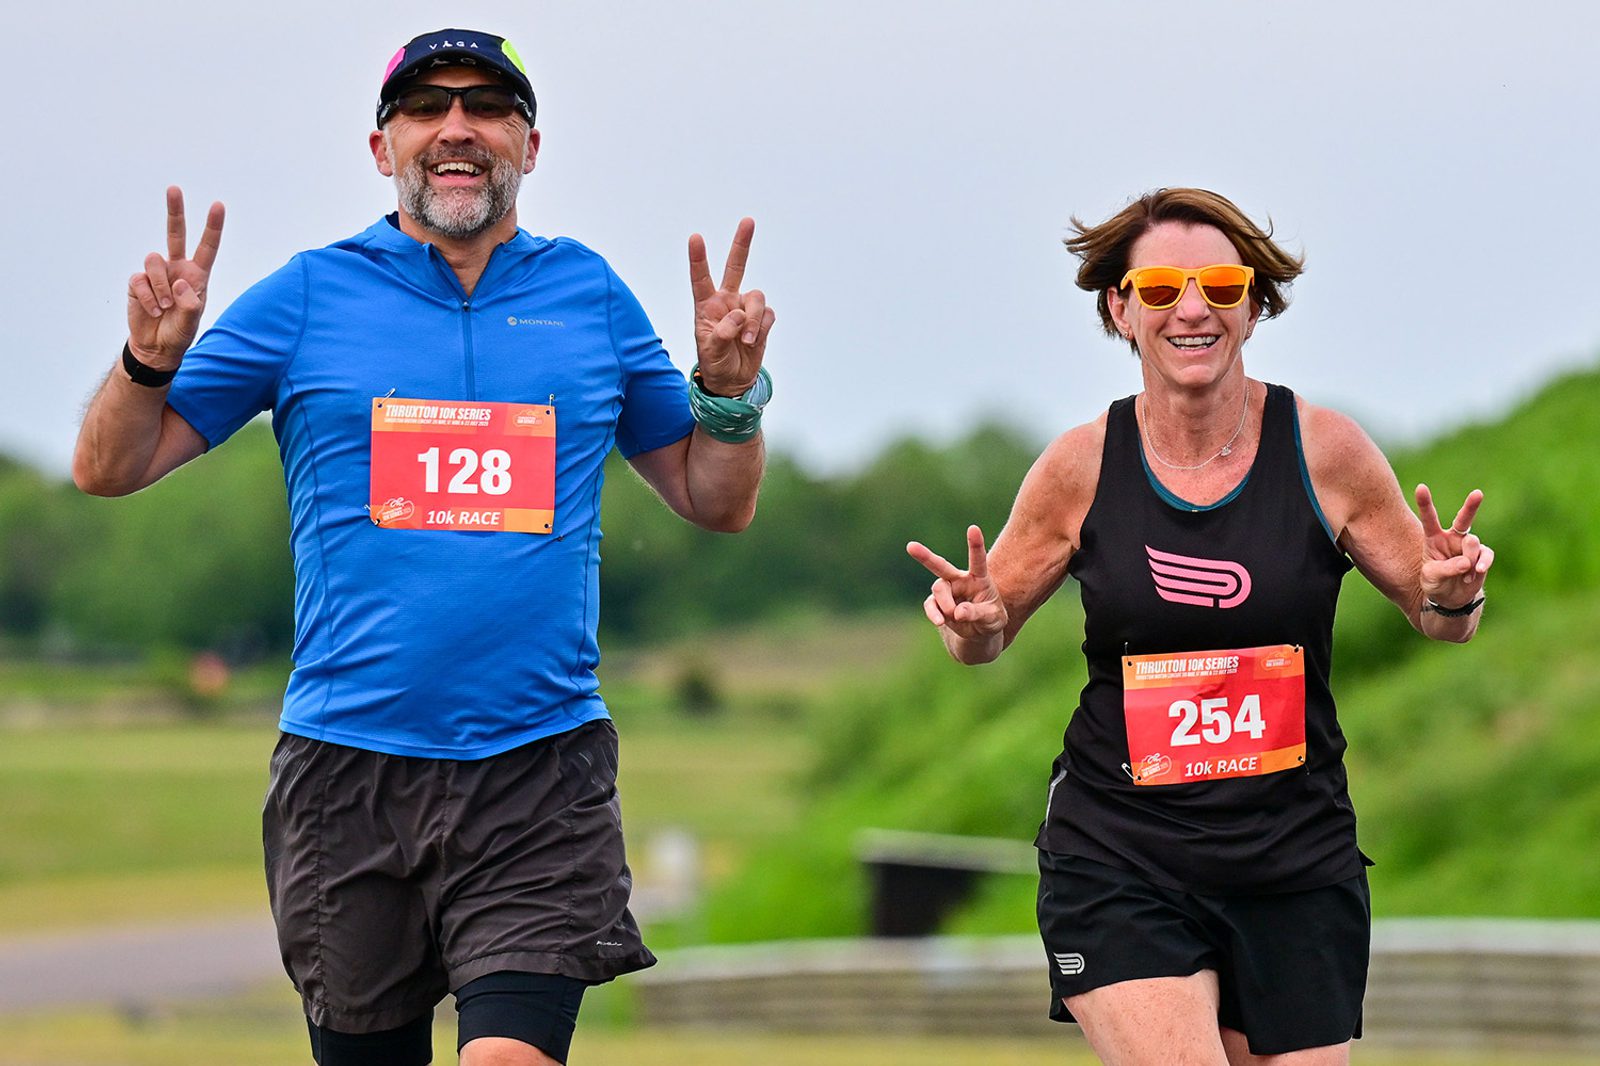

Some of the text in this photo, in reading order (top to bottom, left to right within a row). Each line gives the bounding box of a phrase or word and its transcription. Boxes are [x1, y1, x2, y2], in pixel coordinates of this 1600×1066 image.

[385, 404, 491, 421] THRUXTON 10K SERIES
[417, 447, 512, 495] 128
[426, 510, 456, 524] 10k
[458, 511, 501, 525] RACE
[1135, 659, 1187, 675] THRUXTON
[1187, 658, 1206, 671] 10K
[1205, 656, 1239, 671] SERIES
[1168, 694, 1266, 747] 254
[1184, 760, 1213, 777] 10k
[1217, 756, 1258, 773] RACE
